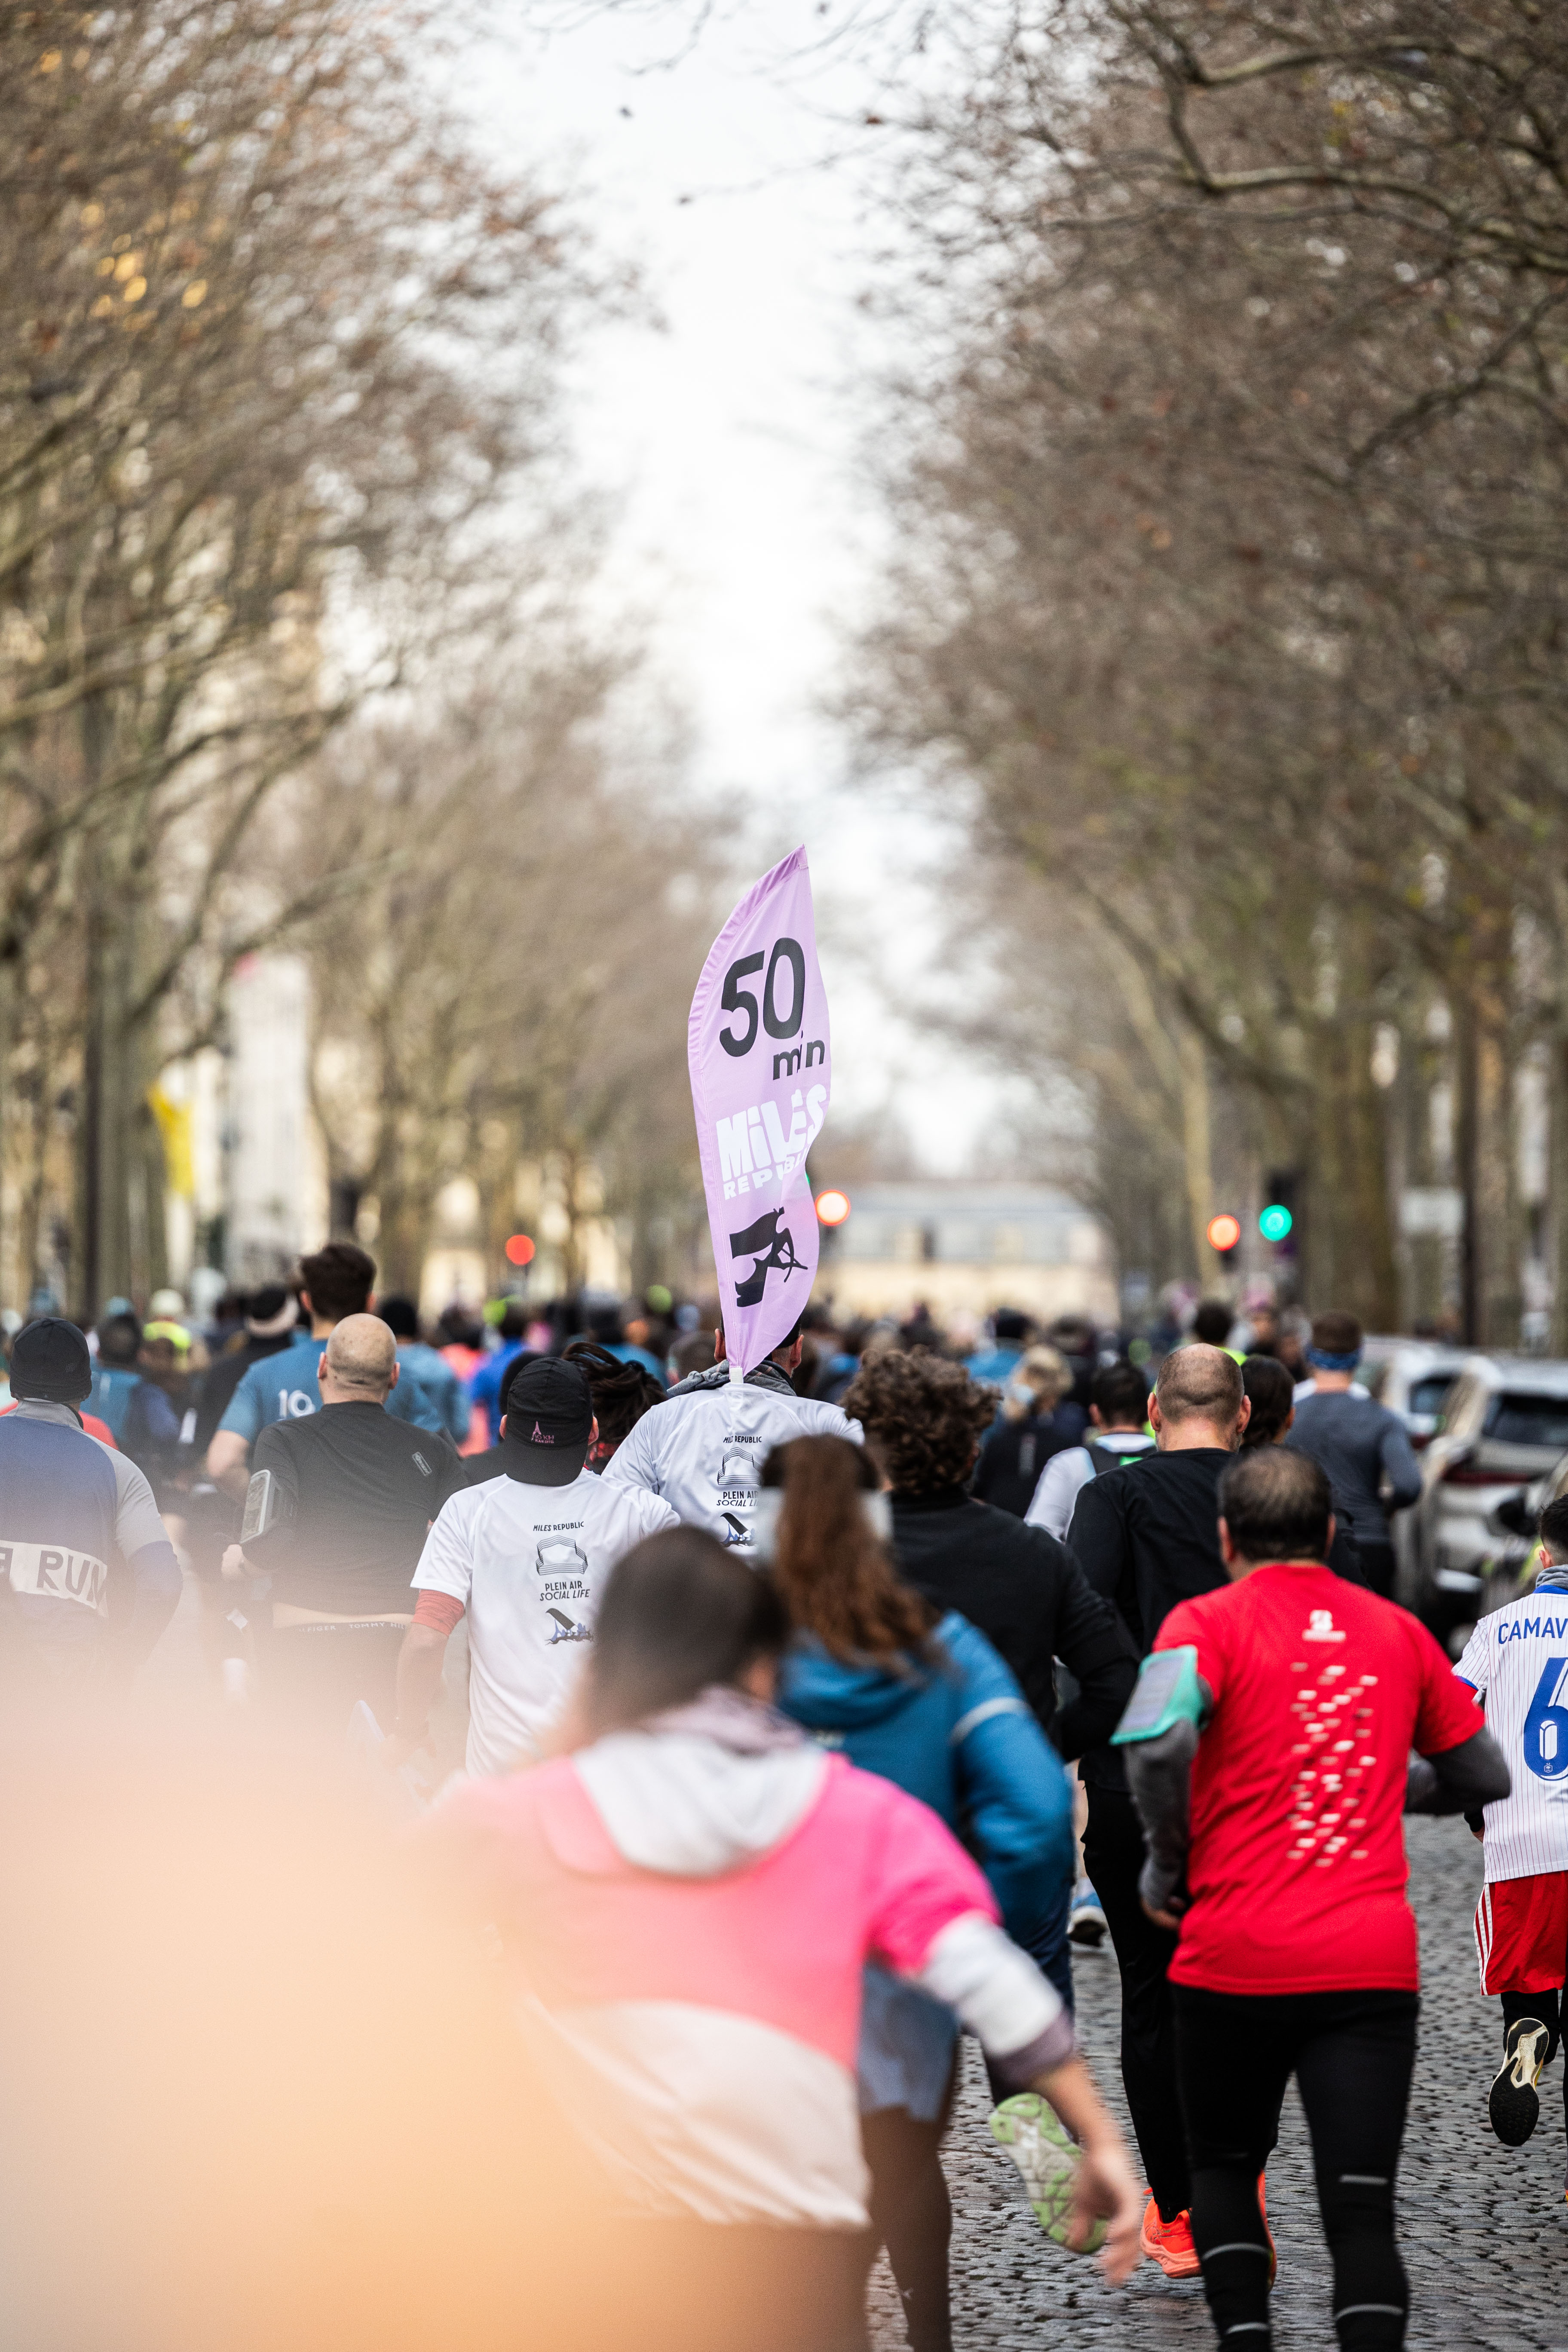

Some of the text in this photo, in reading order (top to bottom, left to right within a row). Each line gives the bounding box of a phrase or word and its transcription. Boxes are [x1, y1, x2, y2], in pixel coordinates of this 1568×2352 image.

[720, 937, 805, 1057] 50
[773, 1030, 825, 1080] min
[723, 1491, 744, 1499] PLEIN
[553, 1521, 584, 1531] REPUBLIC
[540, 1589, 590, 1601] SOCIAL LIFE
[545, 1580, 582, 1591] PLEIN AIR
[1498, 1617, 1568, 1645] CAMAV
[1524, 1657, 1568, 1781] 6
